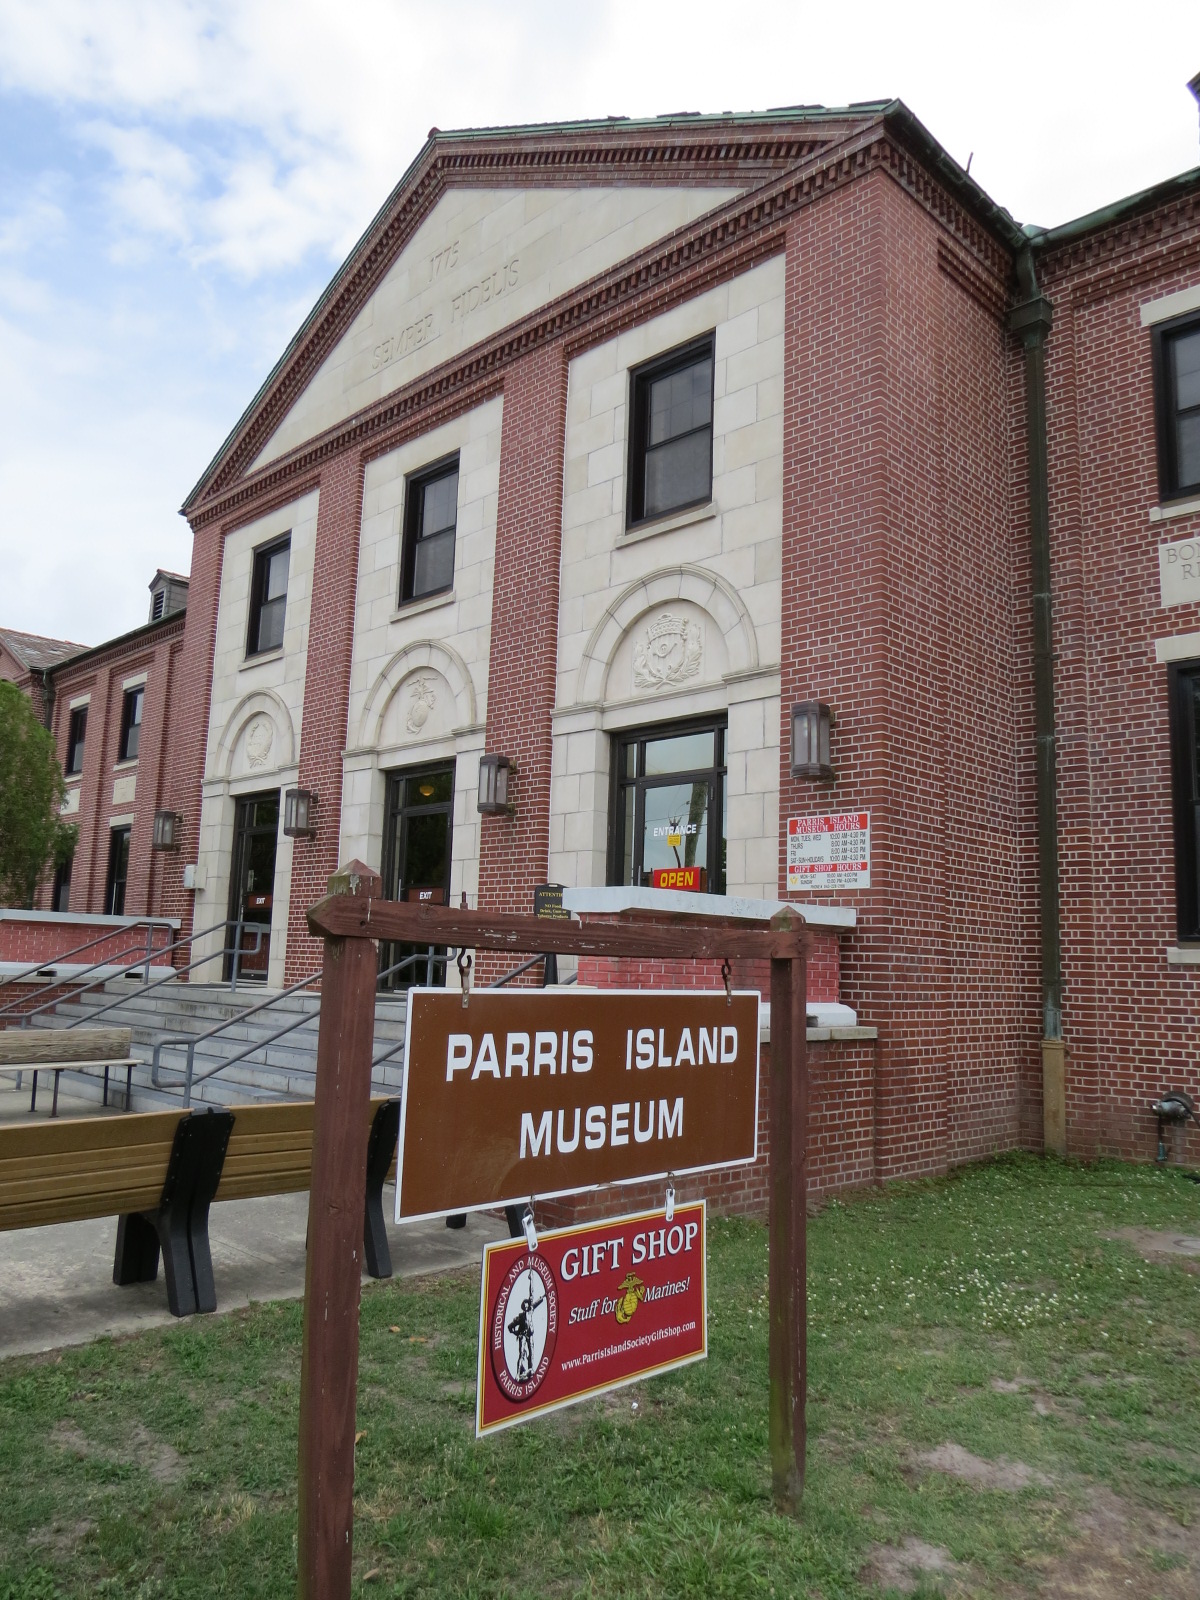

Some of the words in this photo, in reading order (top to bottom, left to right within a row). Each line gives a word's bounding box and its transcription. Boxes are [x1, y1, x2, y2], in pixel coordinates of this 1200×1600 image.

[428, 240, 460, 283] 1775
[372, 313, 434, 369] SEMPER
[451, 259, 519, 323] FIDELIS
[653, 823, 697, 837] ENTRANCE
[796, 824, 829, 834] MUSEUM
[834, 822, 860, 831] HOURS
[797, 817, 825, 827] PARRIS
[830, 814, 859, 824] ISLAND
[660, 871, 694, 888] OPEN
[794, 865, 811, 873] GIFT
[814, 864, 833, 872] SHOP
[836, 862, 862, 871] HOURS
[255, 897, 266, 905] EXIT
[419, 891, 433, 900] EXIT
[445, 1030, 594, 1082] PARRIS
[625, 1026, 738, 1070] ISLAND
[519, 1097, 684, 1159] MUSEUM
[560, 1237, 625, 1281] GIFT
[632, 1222, 698, 1264] SHOP
[494, 1285, 511, 1350] HISTORICAL
[509, 1260, 525, 1283] AND
[527, 1256, 554, 1290] MUSEUM
[548, 1290, 557, 1334] SOCIETY
[568, 1299, 600, 1325] Stuff
[600, 1297, 619, 1315] for
[644, 1277, 690, 1303] Marines!
[561, 1320, 696, 1371] www.ParrisIslandSocietyGiftShop.com
[499, 1369, 523, 1397] PARRIS
[525, 1356, 549, 1395] ISLAND
